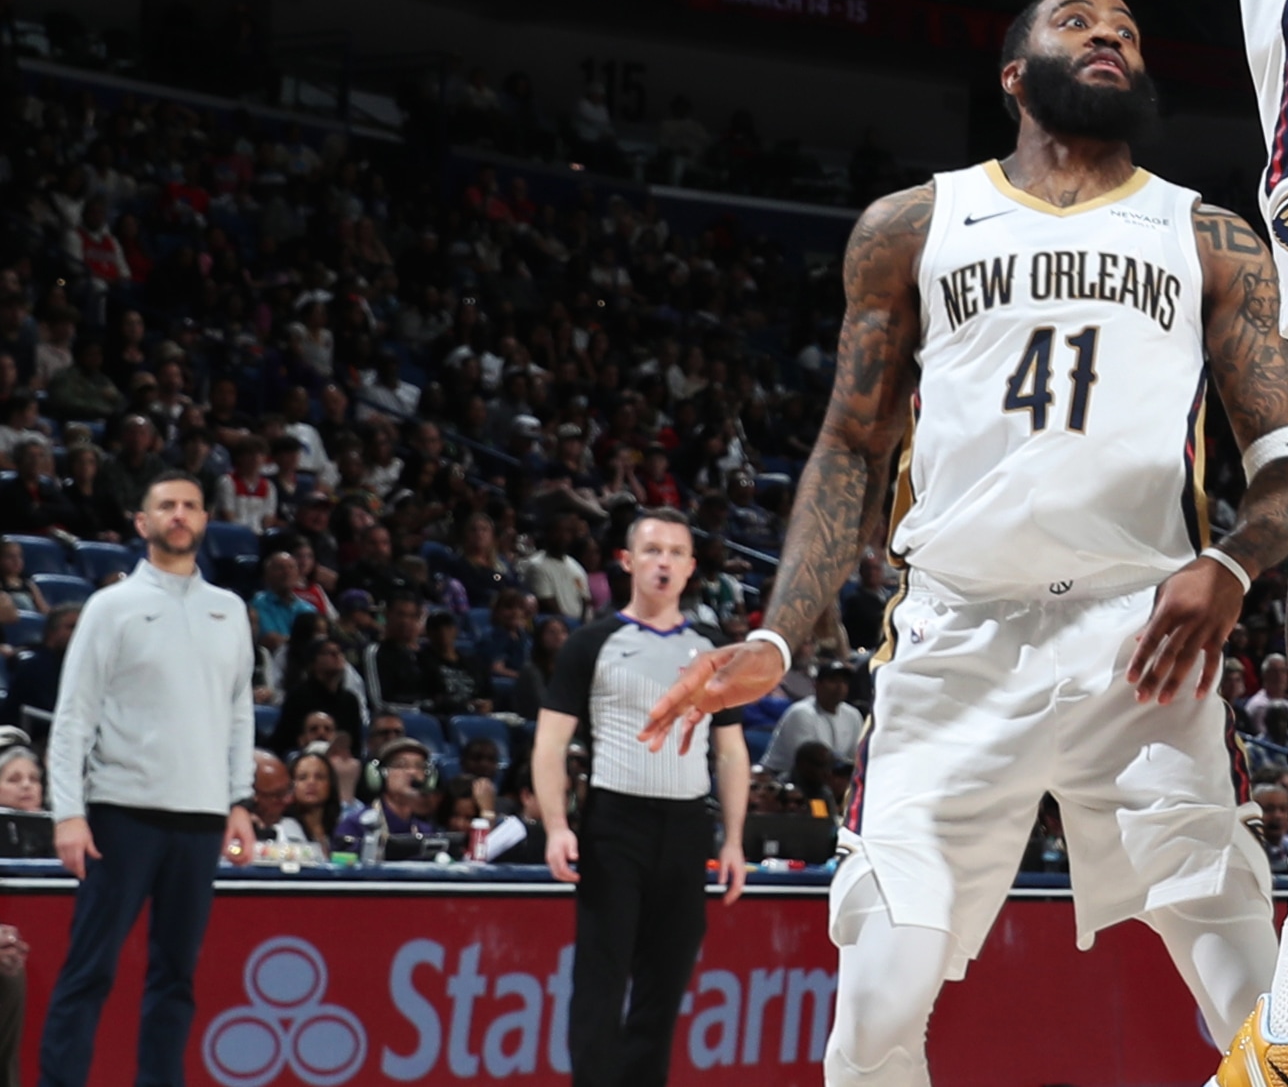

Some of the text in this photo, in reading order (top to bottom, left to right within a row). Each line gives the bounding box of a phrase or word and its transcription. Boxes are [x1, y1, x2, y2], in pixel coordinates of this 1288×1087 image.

[939, 250, 1182, 333] NEW ORLEANS
[1001, 324, 1102, 437] 41
[381, 937, 839, 1082] Stat arm
